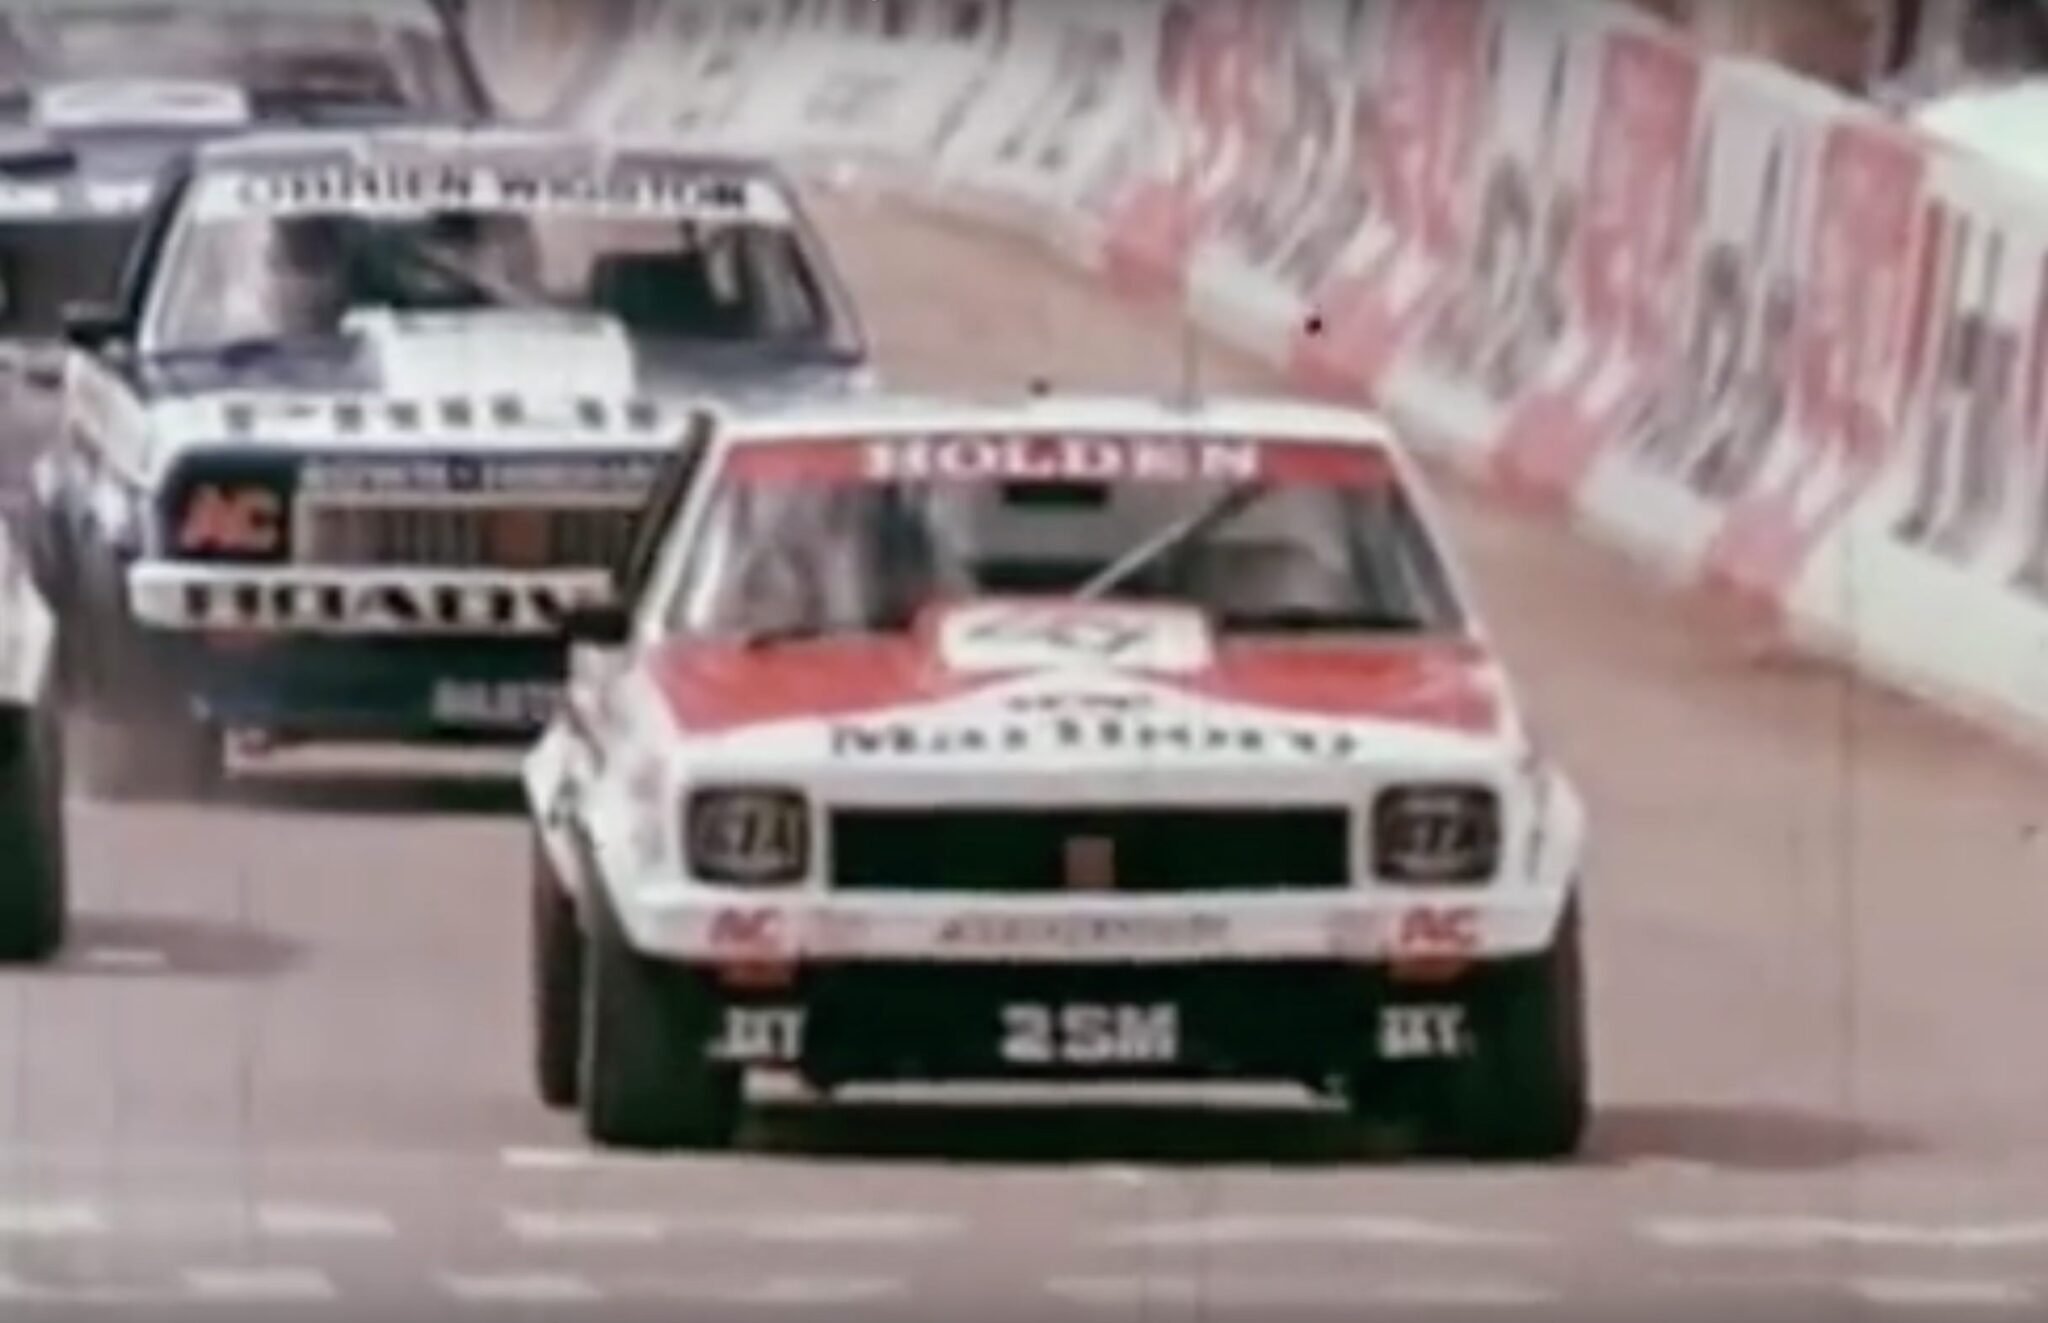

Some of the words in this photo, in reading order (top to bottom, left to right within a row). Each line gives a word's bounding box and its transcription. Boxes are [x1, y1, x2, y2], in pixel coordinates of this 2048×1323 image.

[863, 440, 1260, 479] HOLDEN
[179, 486, 282, 553] AC
[707, 905, 786, 944] AC
[1400, 904, 1484, 945] AC
[999, 1001, 1180, 1062] 2SM
